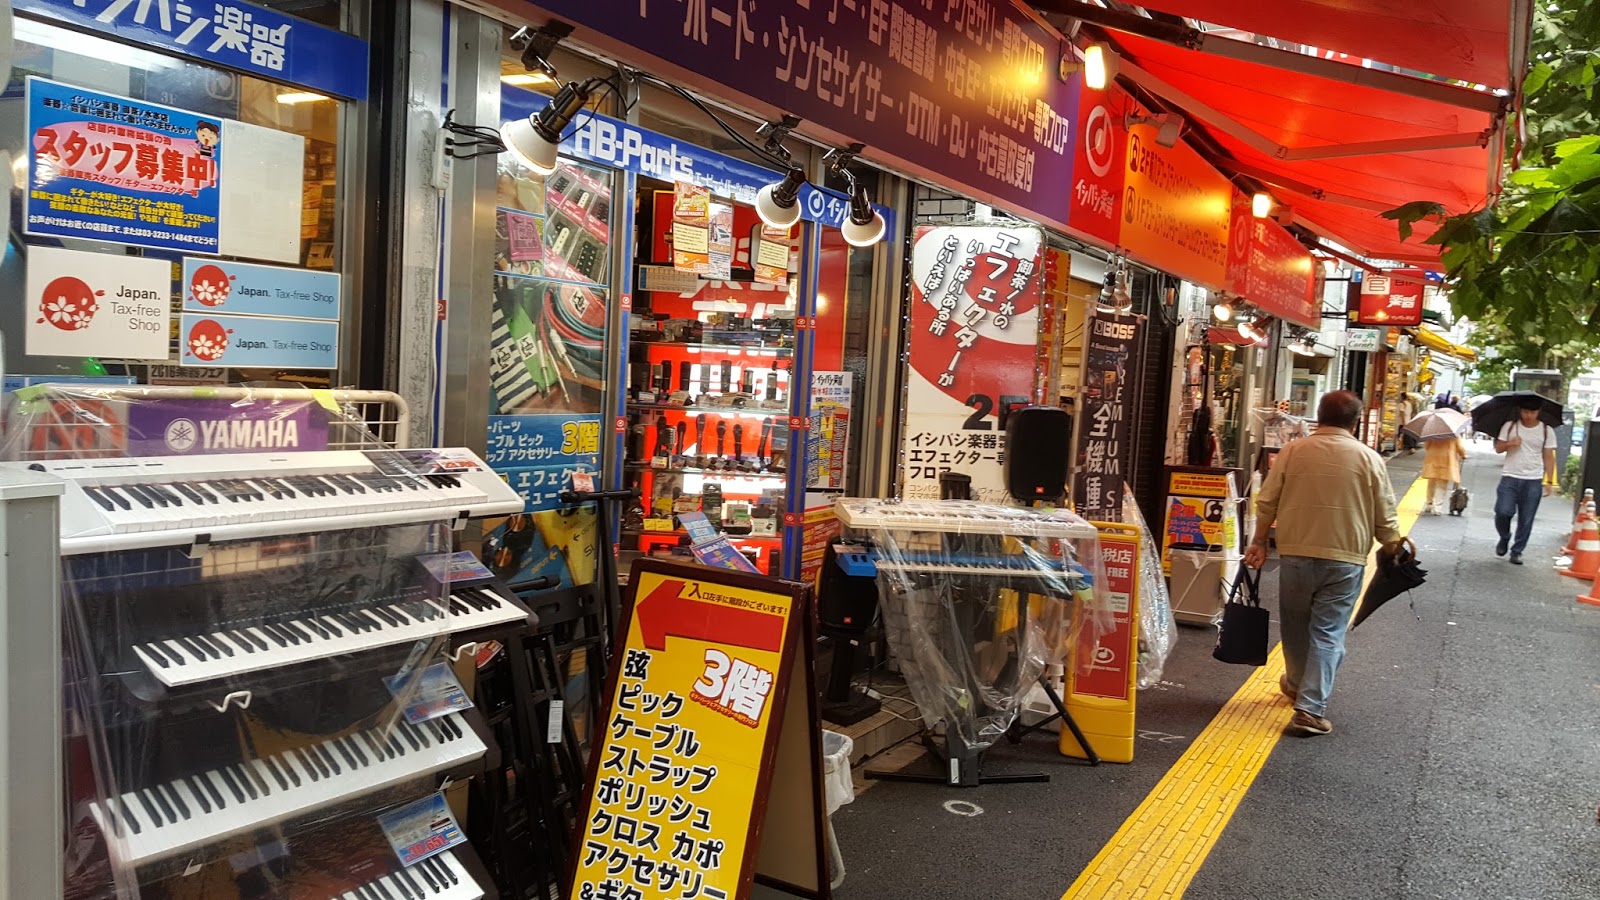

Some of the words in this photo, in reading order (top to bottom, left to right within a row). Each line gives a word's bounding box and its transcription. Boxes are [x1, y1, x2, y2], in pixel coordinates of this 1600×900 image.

[72, 0, 292, 72] バシ楽器
[35, 128, 216, 188] スタッフ募集中!
[574, 114, 694, 182] AB-Parts
[116, 285, 161, 301] Japan.
[237, 285, 271, 298] Japan.
[275, 289, 310, 301] Tax-free
[313, 291, 335, 304] Shop
[928, 239, 984, 337] いっぱいある所
[994, 258, 1034, 330] 御茶ノ水の
[110, 302, 161, 317] Tax-free
[129, 318, 161, 333] Shop
[938, 231, 1020, 388] エフェクターが
[235, 338, 269, 350] Japan.
[273, 339, 308, 351] Tax-free
[309, 341, 332, 353] Shop
[1103, 322, 1136, 340] BOSS
[200, 419, 299, 450] YAMAHA
[518, 434, 544, 446] ピック
[561, 420, 601, 455] 3階
[486, 448, 507, 462] ップ
[509, 447, 560, 460] アクセサリー
[1086, 403, 1112, 510] 全機種
[1107, 567, 1128, 578] FREE
[688, 581, 788, 616] 入口左手に階段がございます!
[624, 650, 651, 680] 弦
[618, 684, 683, 719] ピック
[692, 649, 773, 721] 3階
[611, 716, 700, 758] ケーブル
[603, 745, 717, 793] ストラップ
[597, 777, 711, 832] ポリッシュ
[591, 810, 661, 852] クロス
[671, 832, 724, 869] カポ
[583, 841, 727, 900] アクセサリー
